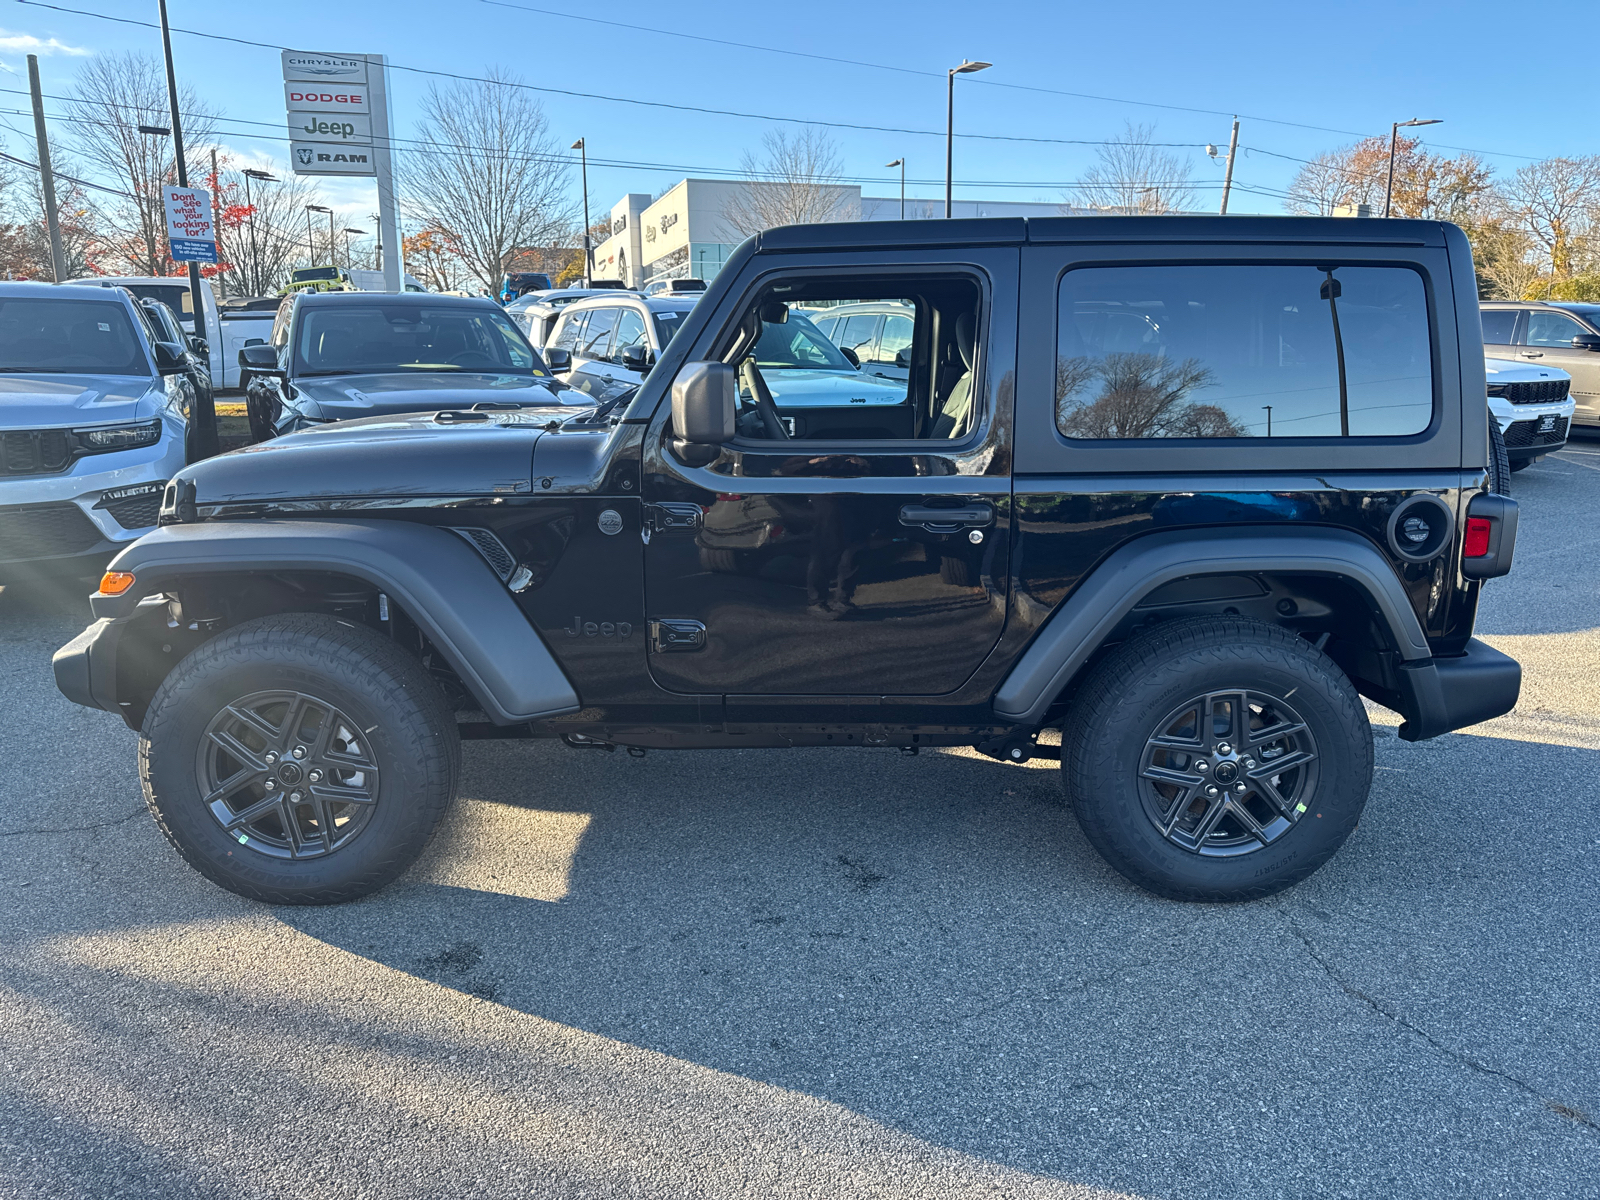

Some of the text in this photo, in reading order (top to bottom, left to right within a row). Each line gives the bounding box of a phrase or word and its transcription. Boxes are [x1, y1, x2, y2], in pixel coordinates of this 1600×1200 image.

[289, 58, 357, 67] CHRYSLER
[290, 92, 363, 104] DODGE
[304, 117, 355, 139] Jeep
[317, 153, 368, 163] RAM
[173, 220, 210, 229] looking
[185, 228, 206, 236] for?
[564, 616, 632, 643] Jeep
